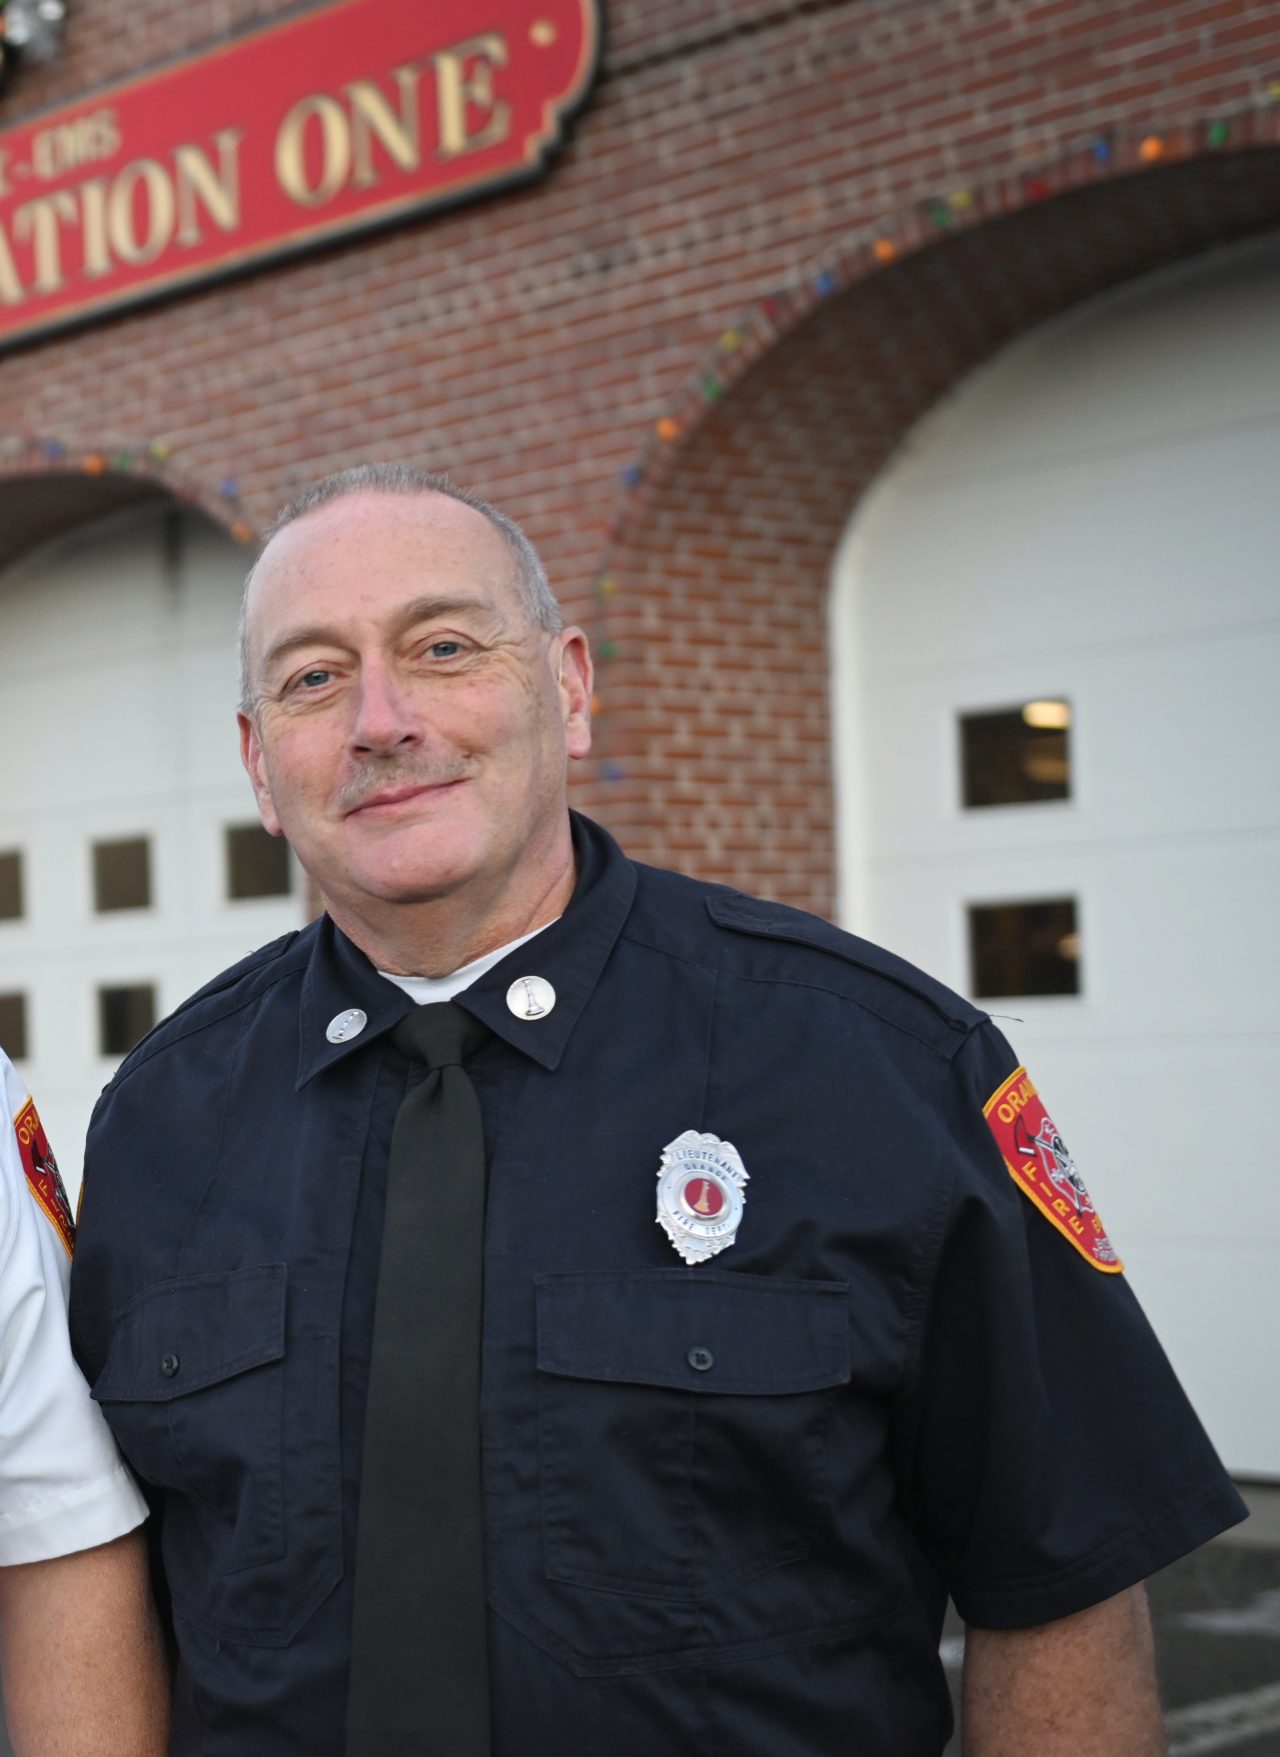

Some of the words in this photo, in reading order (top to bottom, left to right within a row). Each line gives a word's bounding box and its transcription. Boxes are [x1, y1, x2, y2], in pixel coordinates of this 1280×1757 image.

[274, 29, 511, 207] ONE
[997, 1079, 1038, 1123] ORAN
[675, 1149, 738, 1178] LIEUTENANT
[1022, 1160, 1085, 1235] FIRE
